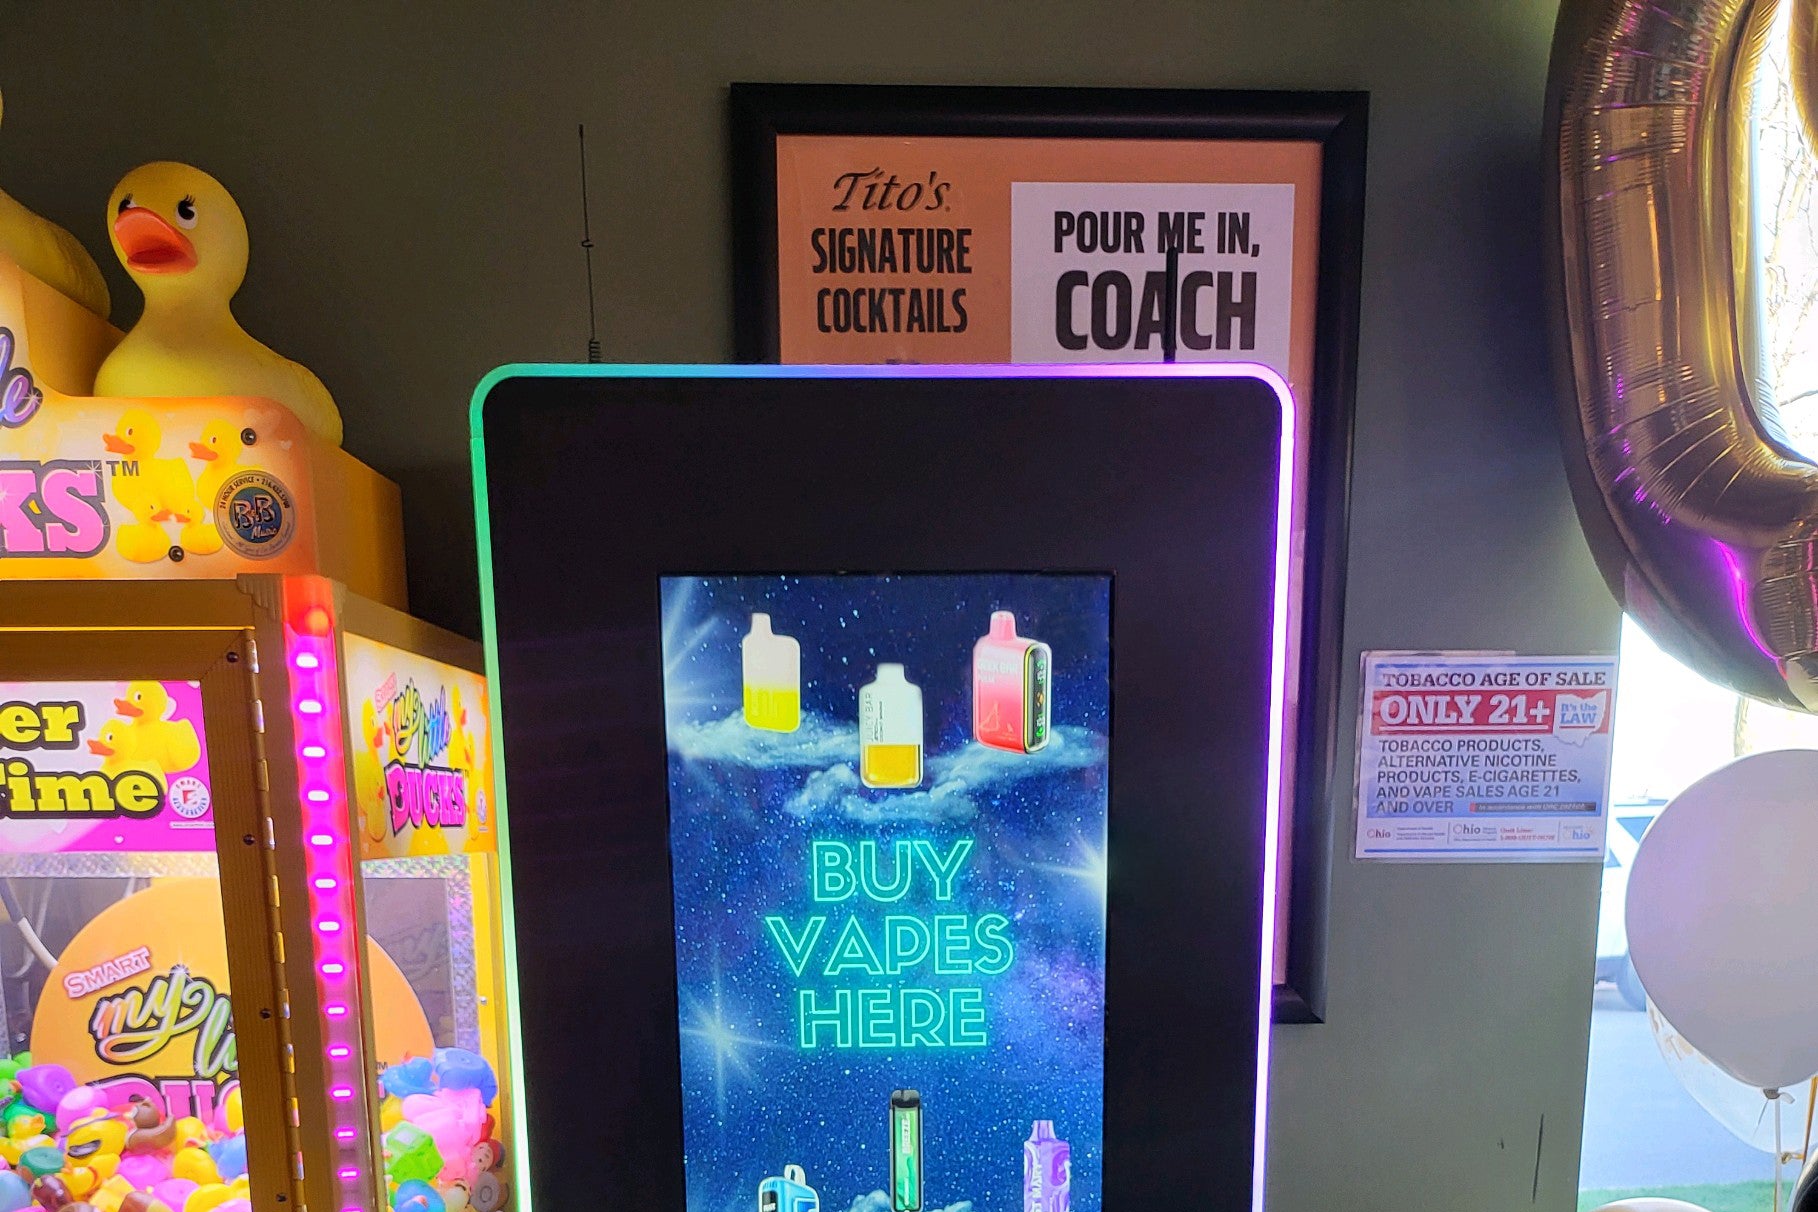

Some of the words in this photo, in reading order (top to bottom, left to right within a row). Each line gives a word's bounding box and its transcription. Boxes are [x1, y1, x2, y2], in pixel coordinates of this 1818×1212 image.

[832, 167, 950, 212] Tito's
[811, 228, 972, 275] SIGNATURE
[1054, 210, 1145, 254] POUR
[1157, 212, 1206, 254] ME
[1217, 212, 1260, 258] IN,
[816, 288, 969, 334] COCKTAILS
[1056, 271, 1258, 350] COACH
[107, 461, 139, 476] TM
[1383, 673, 1475, 688] TOBACCO
[1480, 673, 1520, 687] AGE
[1525, 672, 1551, 686] OF
[1555, 672, 1606, 686] SALE
[1380, 694, 1483, 725] ONLY
[1488, 694, 1550, 725] 21+
[1560, 712, 1597, 724] LAW
[1580, 703, 1597, 711] the
[1377, 754, 1480, 768] ALTERNATIVE
[1484, 754, 1557, 768] NICOTINE
[1379, 740, 1453, 753] TOBACCO
[1457, 739, 1545, 753] PRODUCTS,
[384, 760, 466, 837] DUCKS
[1376, 786, 1410, 798] AND
[1412, 785, 1452, 798] VAPE
[1455, 785, 1504, 798] SALES
[1507, 785, 1539, 798] AGE
[1543, 785, 1560, 797] 21
[1377, 770, 1465, 784] PRODUCTS,
[1468, 769, 1581, 783] E-CIGARETTES,
[1376, 801, 1409, 814] AND
[1412, 801, 1454, 813] OVER
[812, 840, 974, 902] BUY
[765, 913, 1014, 977] VAPES
[63, 946, 151, 999] SMART
[90, 966, 214, 1064] my
[800, 988, 987, 1048] HERE
